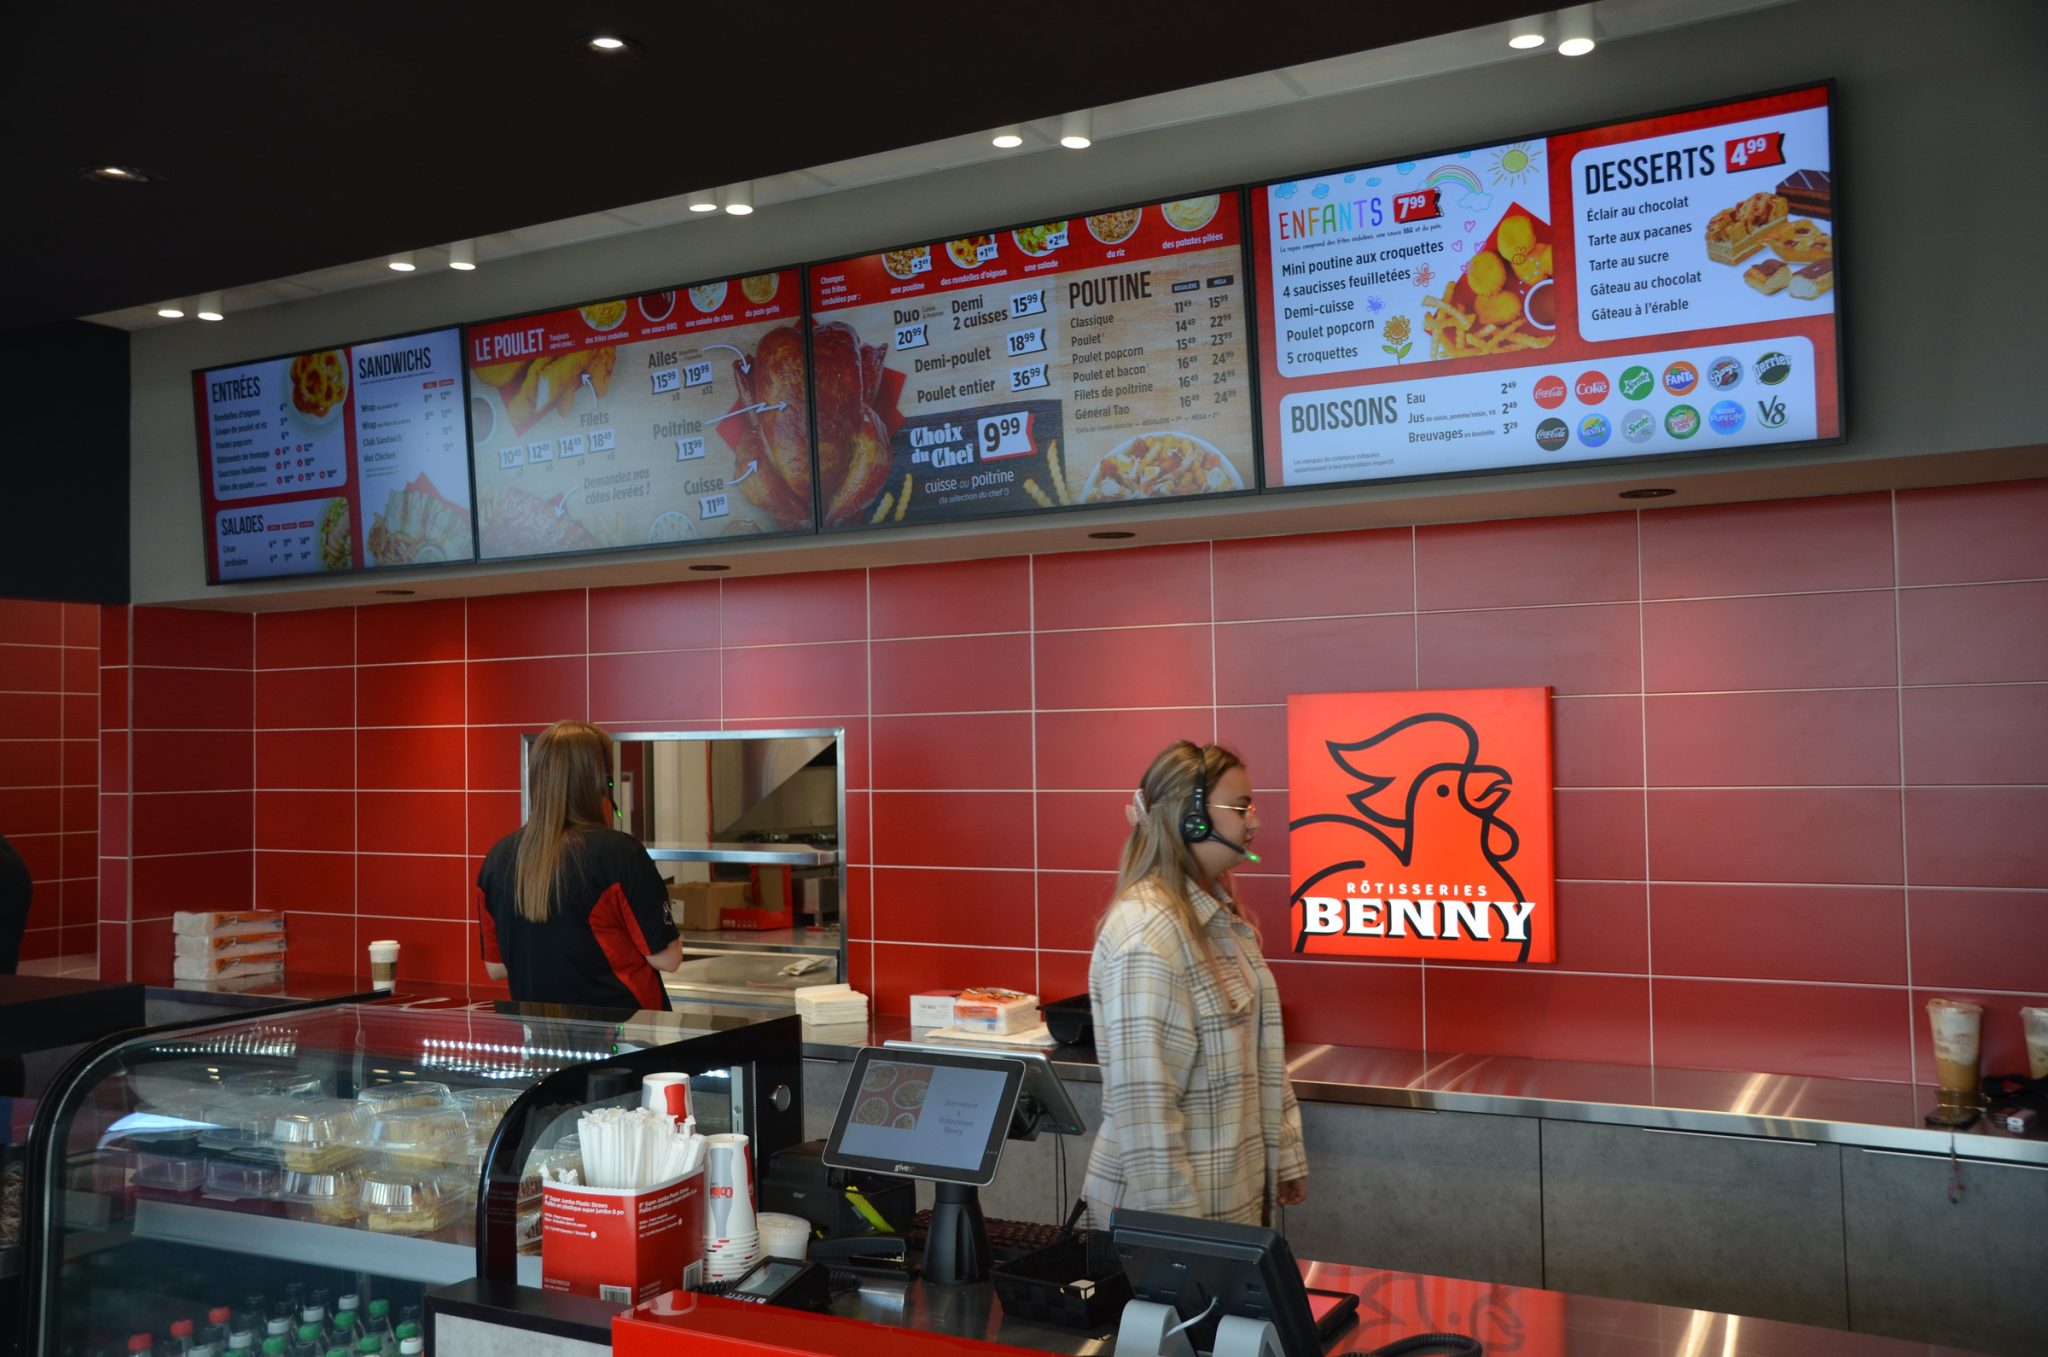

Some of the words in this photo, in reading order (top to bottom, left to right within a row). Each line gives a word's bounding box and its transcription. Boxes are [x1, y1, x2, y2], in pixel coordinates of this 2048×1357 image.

[1585, 144, 1715, 195] DESSERTS
[1587, 205, 1618, 222] Éclair
[1622, 205, 1636, 216] au
[1638, 196, 1689, 214] chocolat
[1279, 198, 1383, 240] ENFANTS
[1162, 240, 1174, 250] des
[1174, 236, 1202, 248] patates
[1202, 232, 1224, 246] pilées
[1588, 232, 1617, 247] Tarte
[1620, 231, 1640, 243] aux
[1644, 222, 1692, 241] pacanes
[1106, 250, 1116, 258] du
[1117, 248, 1126, 258] riz
[1282, 262, 1306, 277] Mini
[1308, 255, 1353, 276] poutine
[1356, 252, 1376, 264] aux
[1380, 241, 1444, 262] croquettes
[1590, 258, 1618, 272] Tarte
[1622, 256, 1636, 268] au
[1638, 251, 1670, 266] sucre
[1024, 264, 1036, 272] une
[1036, 259, 1058, 271] salade
[890, 286, 901, 294] une
[902, 282, 925, 293] poutine
[940, 277, 952, 286] des
[952, 272, 980, 284] rondelles
[1283, 286, 1290, 298] 4
[1294, 278, 1346, 296] saucisses
[1350, 268, 1411, 288] feuilletées
[1590, 281, 1630, 296] Gâteau
[1634, 279, 1648, 290] au
[1651, 271, 1702, 289] chocolat
[1069, 271, 1152, 310] POUTINE
[952, 295, 984, 314] Demi
[1284, 300, 1354, 320] Demi-cuisse
[1592, 305, 1632, 321] Gâteau
[1636, 303, 1642, 316] à
[1645, 299, 1689, 315] l'érable
[894, 308, 920, 324] Duo
[953, 318, 961, 330] 2
[964, 309, 1008, 328] cuisses
[1070, 313, 1114, 328] Classique
[1071, 333, 1102, 347] Poulet
[1286, 325, 1324, 342] Poulet
[1326, 320, 1374, 339] popcorn
[475, 337, 492, 362] LE
[494, 328, 544, 359] POULET
[359, 346, 431, 379] SANDWICHS
[648, 350, 678, 369] Ailes
[914, 346, 991, 372] Demi-poulet
[1072, 350, 1101, 364] Poulet
[1104, 346, 1144, 361] popcorn
[1287, 352, 1294, 364] 5
[1297, 346, 1358, 363] croquettes
[1073, 370, 1102, 383] Poulet
[1106, 366, 1115, 378] et
[1117, 364, 1147, 377] bacon
[1626, 374, 1648, 390] Sprite
[211, 374, 261, 403] ENTRÉES
[918, 386, 956, 403] Poulet
[959, 379, 996, 396] entier
[1074, 387, 1100, 401] Filets
[1102, 386, 1113, 398] de
[1116, 382, 1153, 397] poitrine
[1576, 382, 1608, 396] Coke
[1407, 393, 1426, 404] Eau
[1076, 406, 1111, 421] Général
[1114, 404, 1130, 415] Tao
[1291, 395, 1398, 433] BOISSONS
[1408, 412, 1425, 424] Jus
[1758, 394, 1786, 424] V8
[580, 412, 609, 428] Filets
[653, 419, 702, 440] Poitrine
[1628, 416, 1649, 435] Sprite
[363, 438, 376, 447] Club
[376, 434, 402, 445] Sandwich
[910, 422, 963, 448] Choix
[1408, 429, 1464, 443] Breuvages
[364, 454, 374, 464] Hot
[375, 452, 396, 462] Chicken
[912, 449, 930, 464] du
[931, 442, 974, 468] Chef
[584, 471, 632, 490] Demandez
[633, 468, 650, 480] nos
[684, 478, 724, 496] Cuisse
[924, 478, 956, 494] cuisse
[959, 480, 969, 488] ou
[972, 470, 1014, 489] poitrine
[585, 490, 610, 505] côtes
[612, 486, 645, 500] levées
[222, 514, 264, 536] SALADES
[1347, 880, 1488, 897] RÔTISSERIES
[1302, 896, 1536, 942] BENNY
